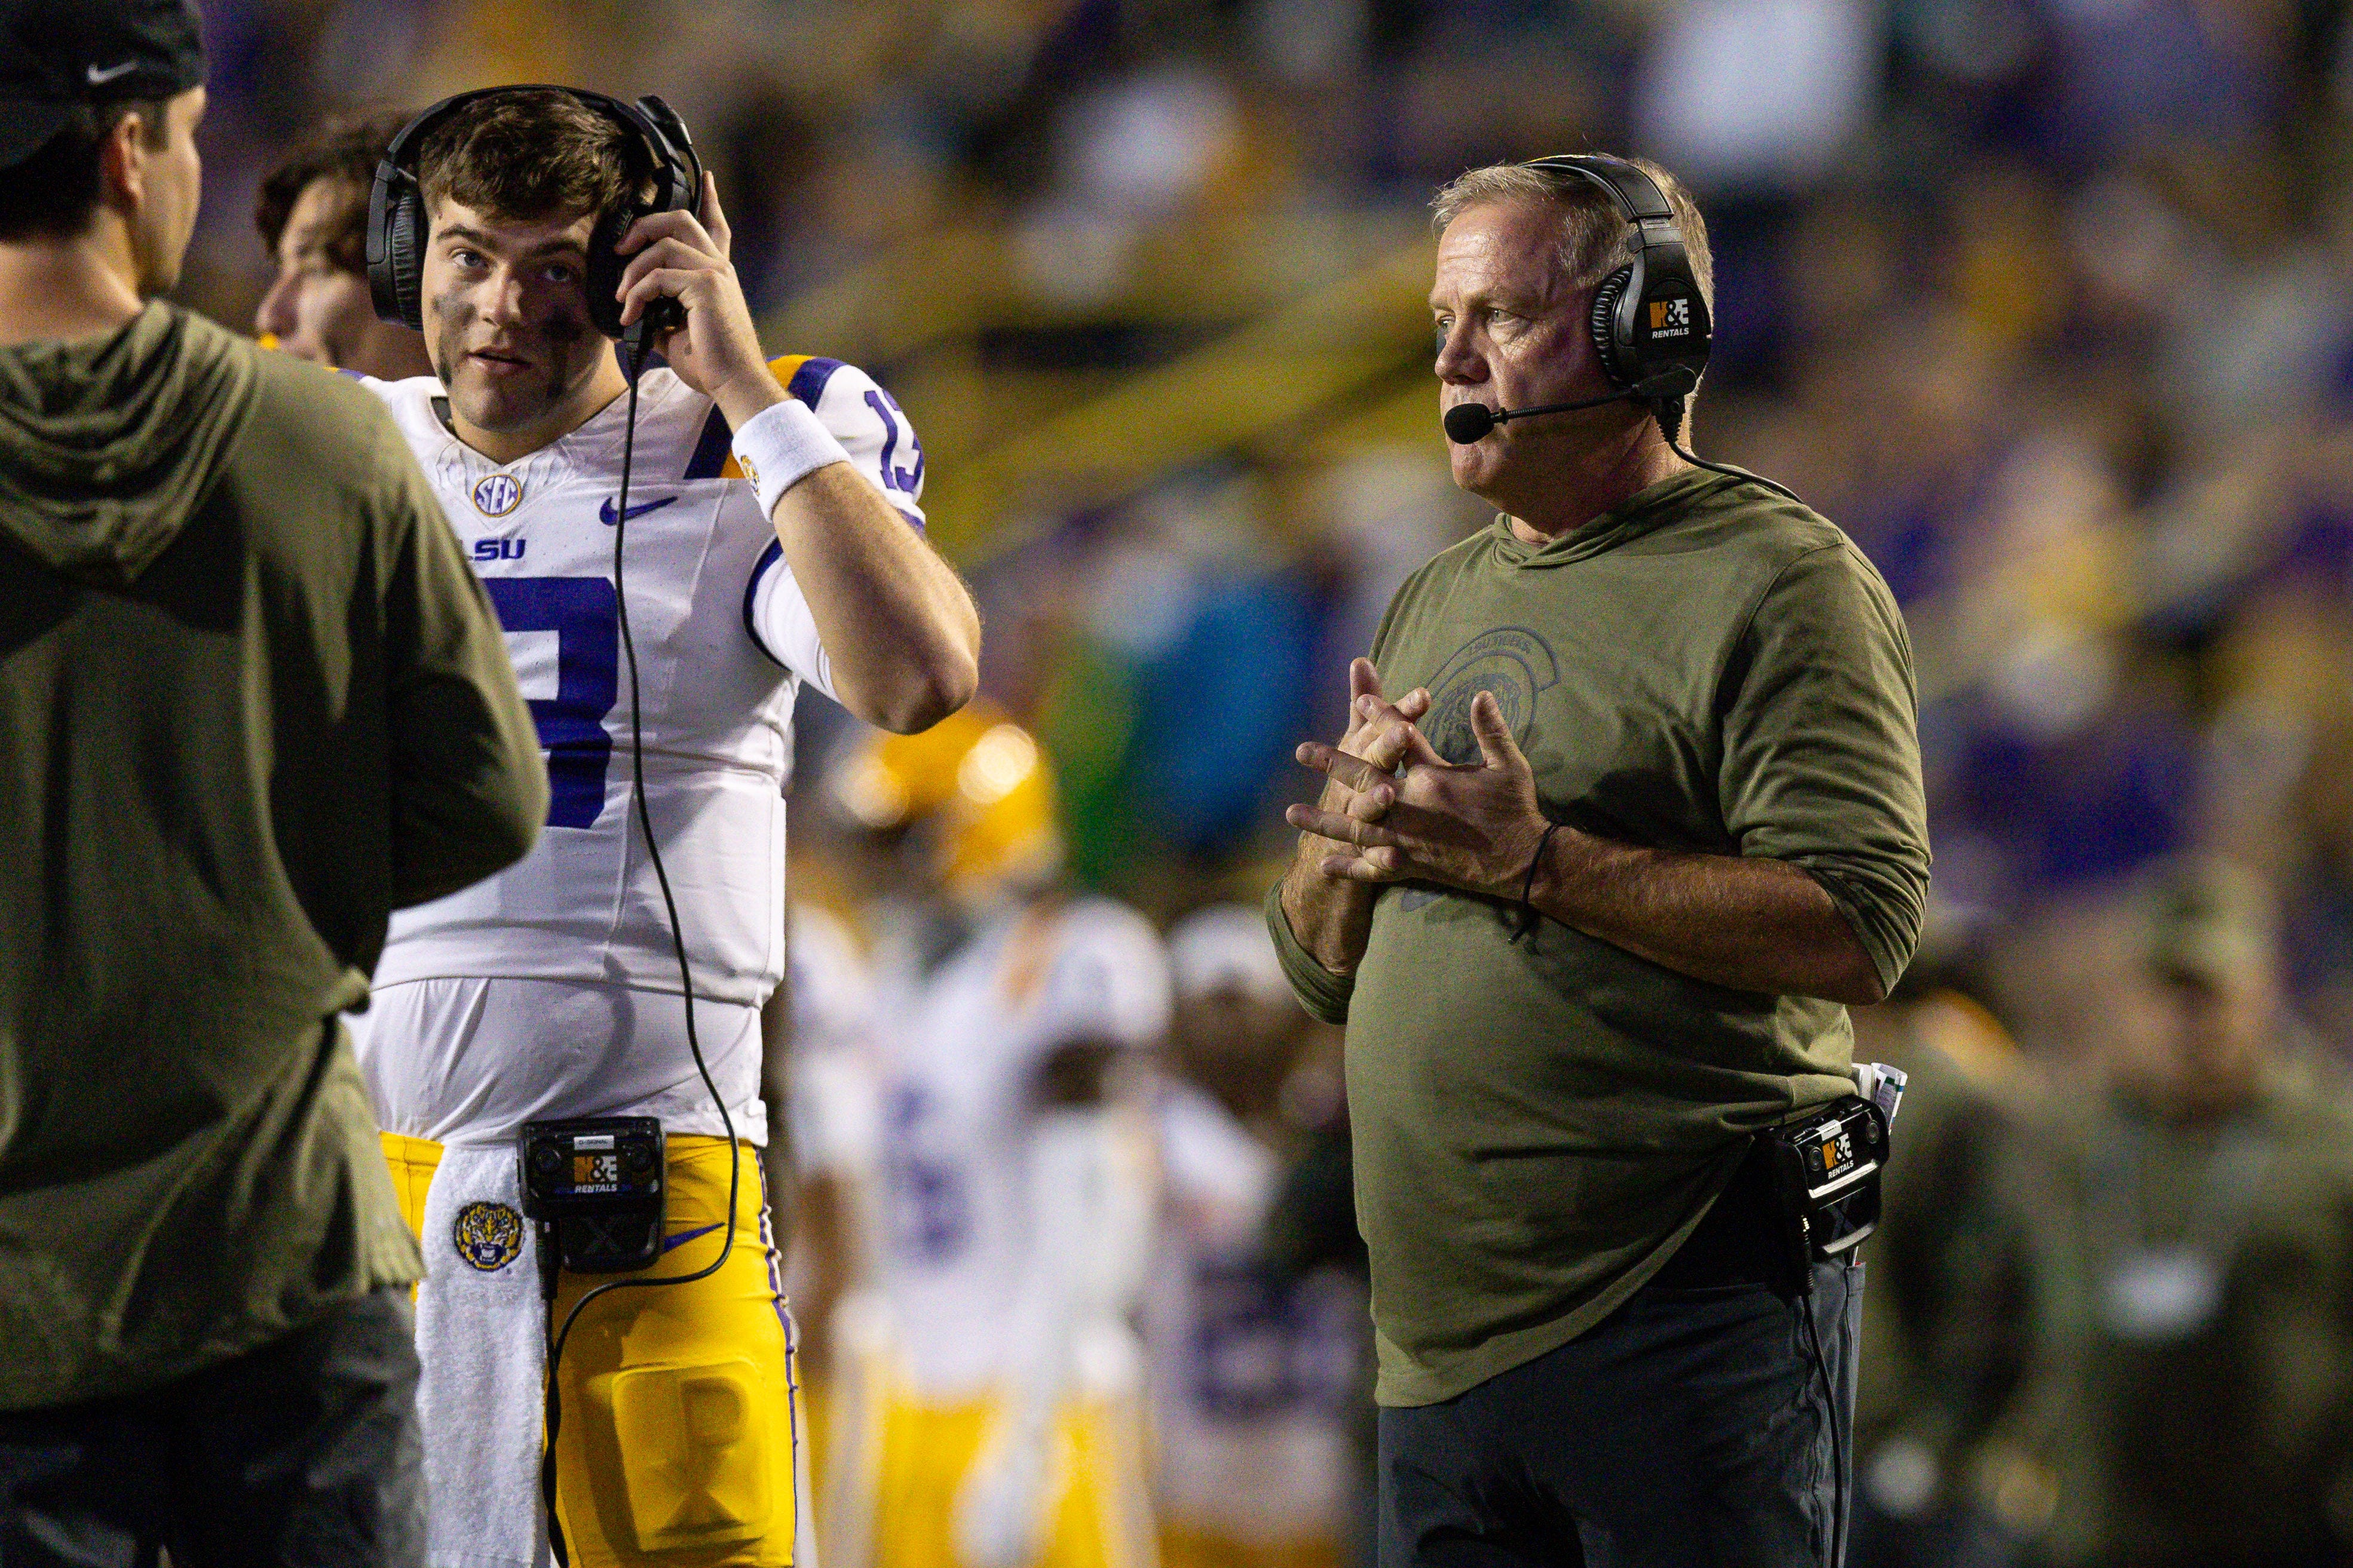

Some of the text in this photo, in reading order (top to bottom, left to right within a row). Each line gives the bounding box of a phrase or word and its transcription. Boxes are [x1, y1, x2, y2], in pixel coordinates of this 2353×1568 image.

[1650, 299, 1689, 329] H&E
[1652, 327, 1690, 339] RENTALS
[475, 476, 520, 514] SEC
[471, 538, 527, 561] SU
[1822, 1133, 1853, 1170] H&E
[574, 1156, 618, 1182] H&E
[1828, 1159, 1854, 1180] RENTALS
[574, 1183, 617, 1194] RENTALS
